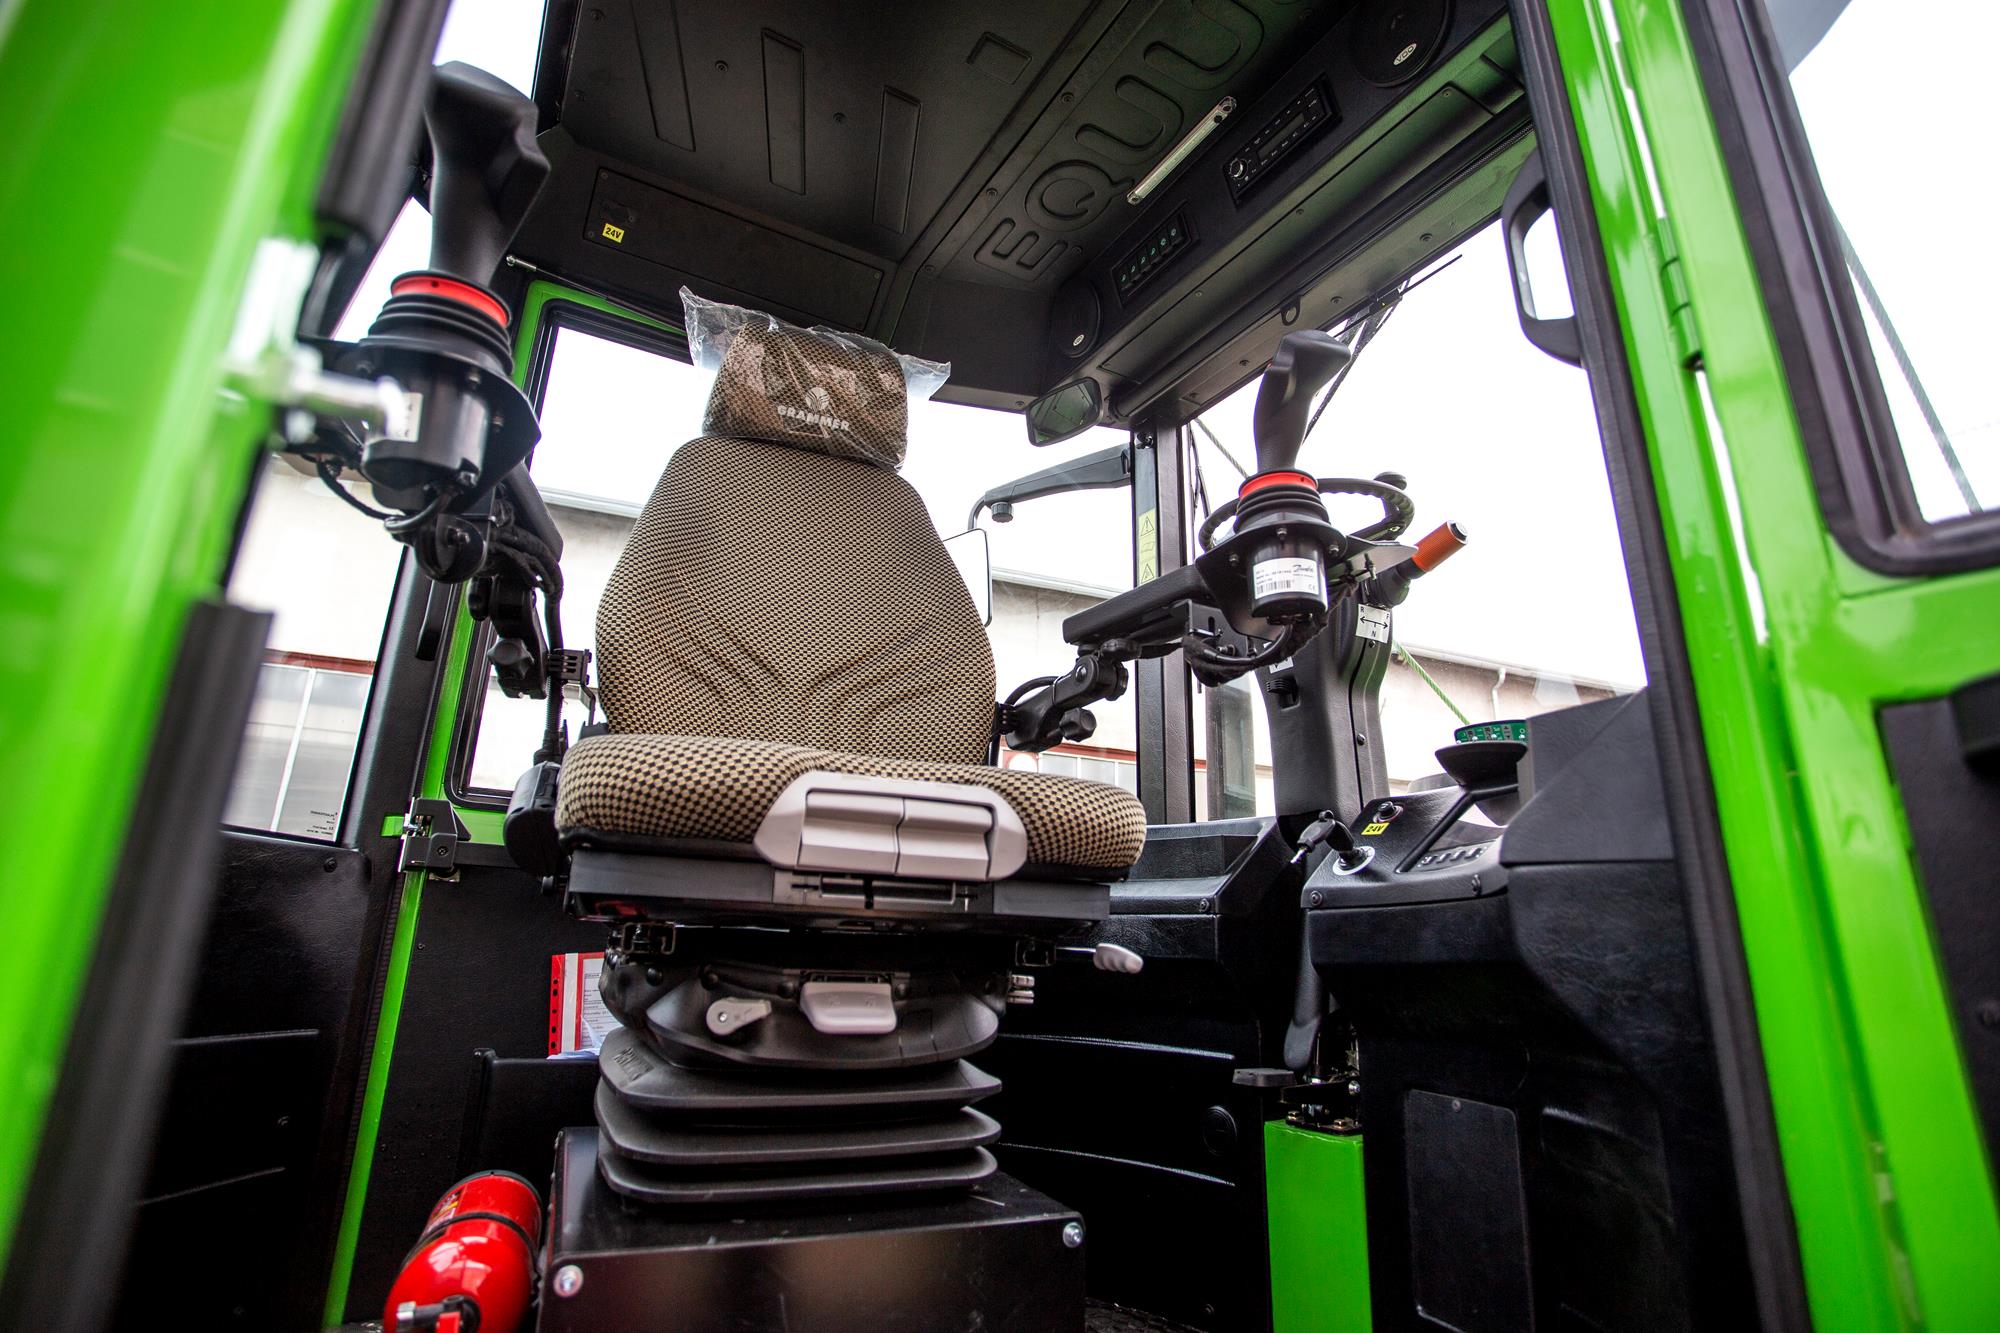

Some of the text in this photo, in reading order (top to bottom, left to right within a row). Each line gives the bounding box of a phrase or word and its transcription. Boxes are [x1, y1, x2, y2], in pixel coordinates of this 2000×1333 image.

[973, 0, 1298, 282] EQUU
[605, 227, 621, 239] 24V
[777, 405, 849, 431] GRAMMER
